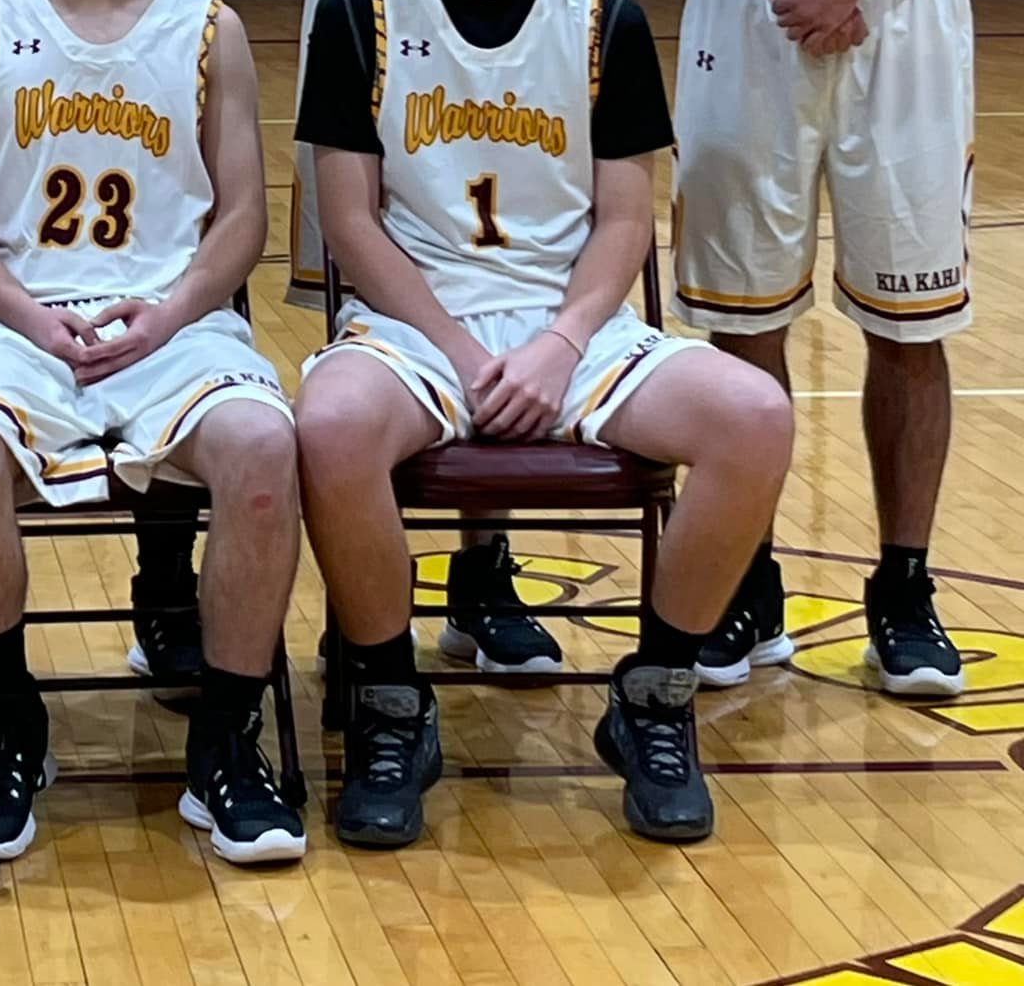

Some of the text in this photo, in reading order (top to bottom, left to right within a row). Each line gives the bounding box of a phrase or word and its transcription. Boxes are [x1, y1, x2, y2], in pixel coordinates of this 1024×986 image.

[15, 79, 171, 157] Warriors
[404, 84, 567, 158] Warriors
[37, 163, 137, 251] 23
[465, 172, 512, 251] 1
[875, 271, 911, 293] KIA
